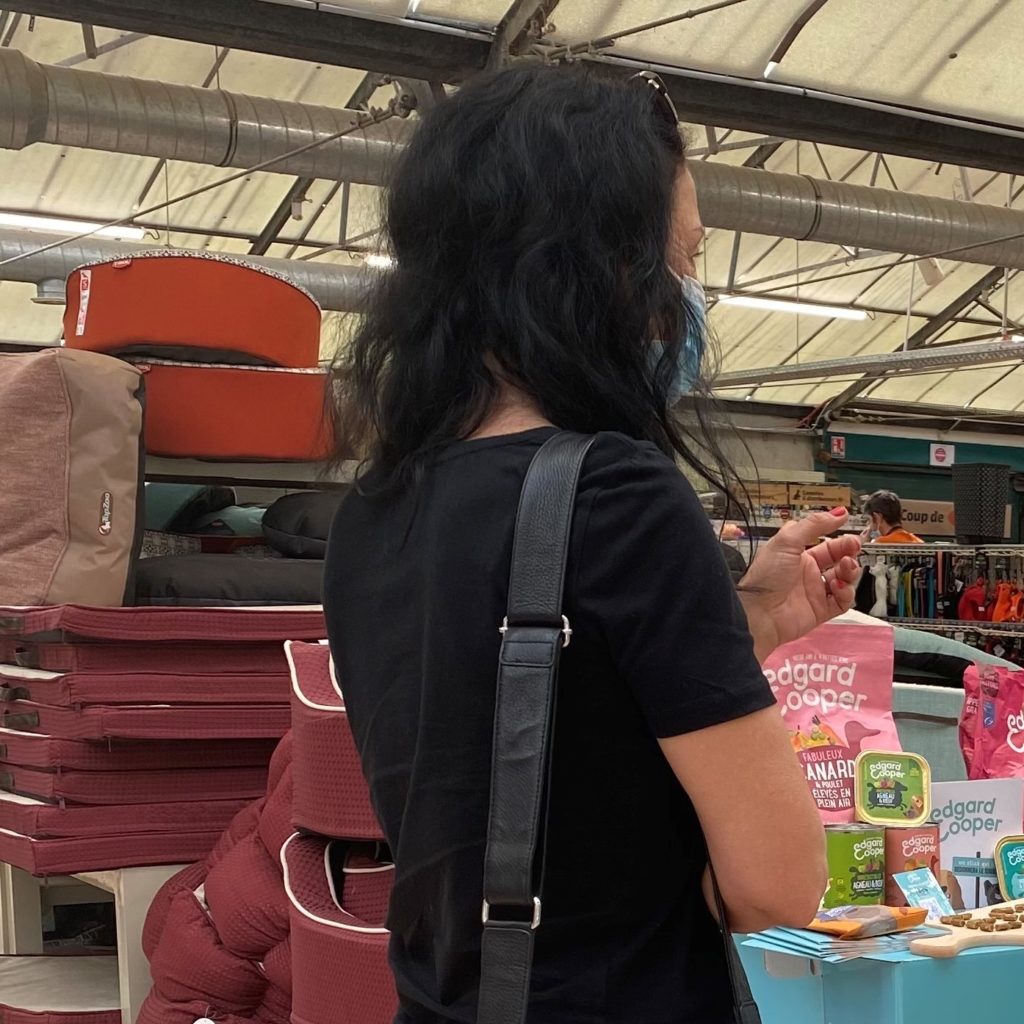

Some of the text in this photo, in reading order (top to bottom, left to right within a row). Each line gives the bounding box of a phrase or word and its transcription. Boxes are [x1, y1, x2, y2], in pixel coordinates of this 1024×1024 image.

[901, 509, 944, 524] Coup de
[763, 659, 857, 690] edgard
[803, 749, 843, 762] FABULEUX
[800, 759, 856, 781] ANARD
[870, 761, 902, 774] edgard
[870, 767, 906, 779] Cooper
[822, 779, 844, 788] POULET
[840, 787, 851, 798] EN
[817, 798, 851, 808] PLEIN AIR
[930, 798, 997, 821] edgard
[902, 836, 934, 849] edgard
[854, 848, 884, 860] Coope
[902, 844, 937, 857] Cooper
